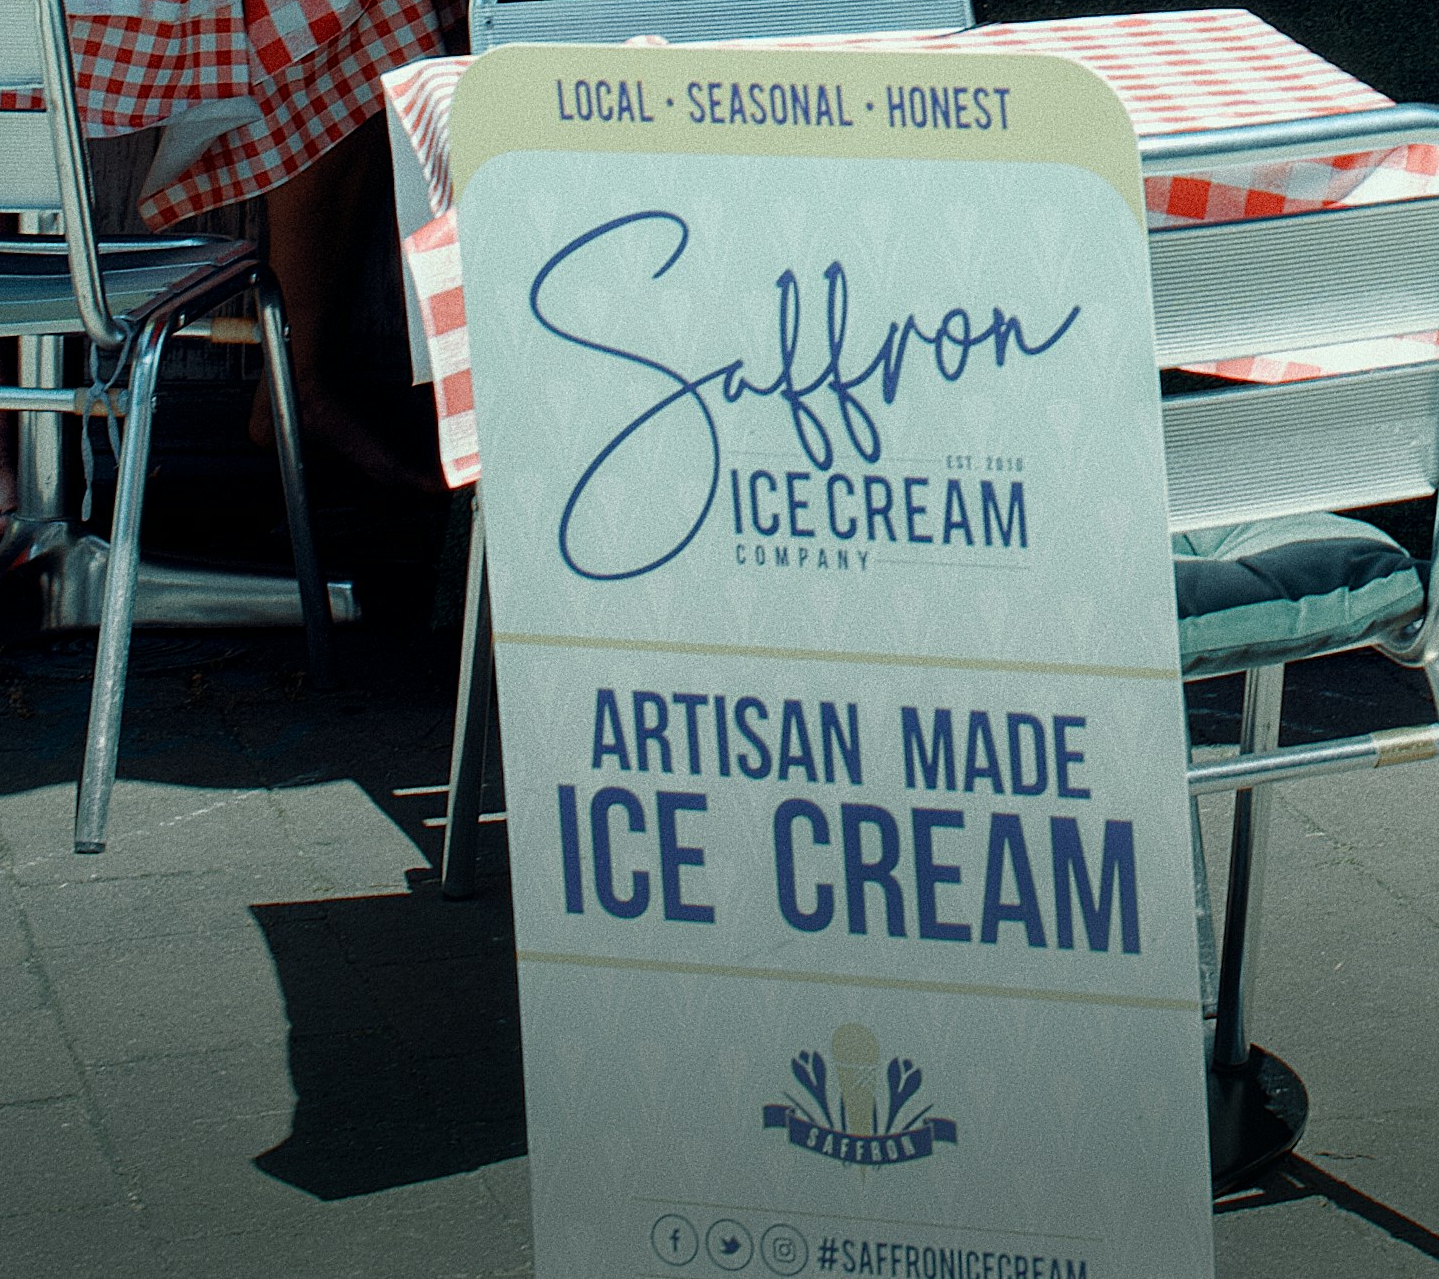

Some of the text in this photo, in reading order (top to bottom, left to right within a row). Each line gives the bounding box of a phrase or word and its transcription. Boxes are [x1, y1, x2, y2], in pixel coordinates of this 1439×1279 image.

[556, 79, 1012, 132] LOCAL SEASONAL HONEST
[528, 209, 1083, 581] Saffron
[735, 543, 869, 572] COMPANY
[591, 688, 1092, 801] ARTISAN MADE
[556, 782, 1142, 957] ICE CREAM
[806, 1127, 916, 1162] SAFFRON
[816, 1236, 1089, 1279] #SAFFRONICECREAM
